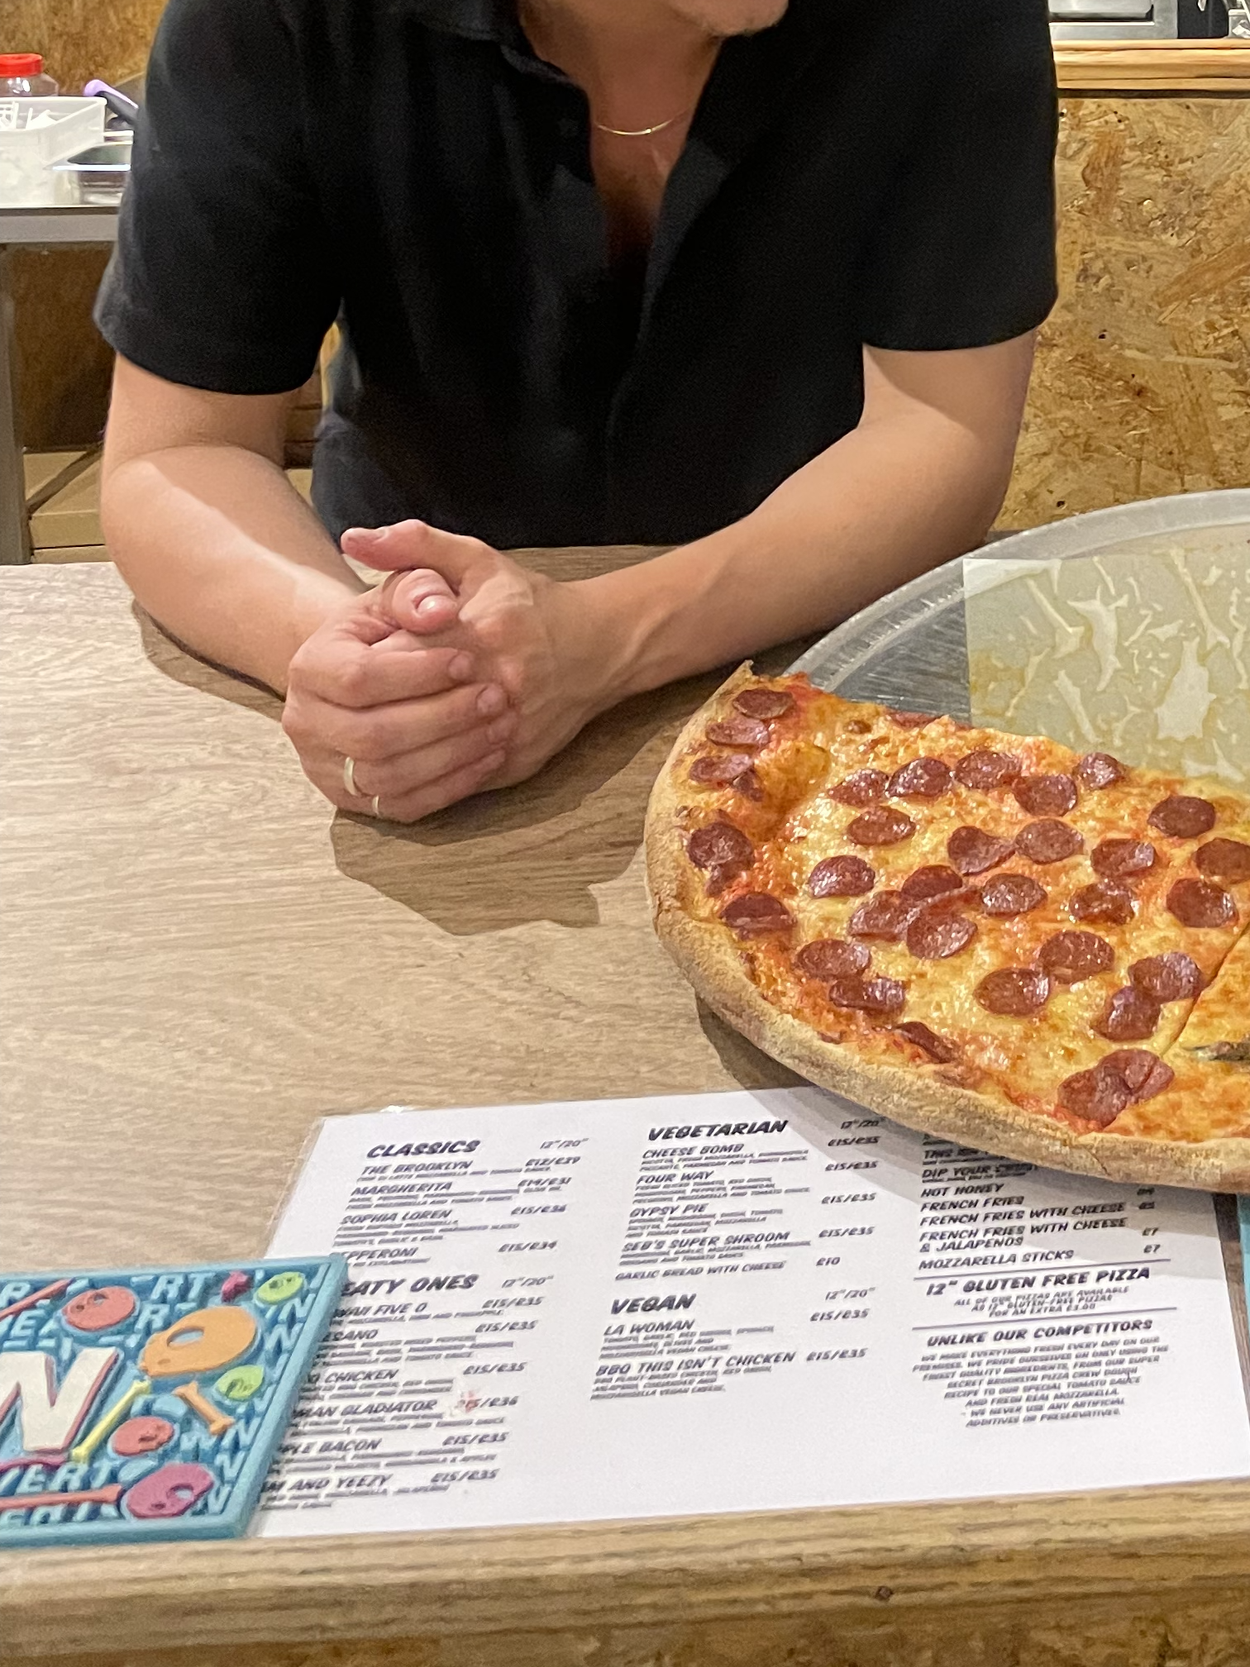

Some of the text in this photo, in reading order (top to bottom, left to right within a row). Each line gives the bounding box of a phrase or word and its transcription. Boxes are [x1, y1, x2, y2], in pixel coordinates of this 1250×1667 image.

[648, 1120, 789, 1142] VEGETARIAN
[366, 1140, 482, 1159] CLASSICS
[642, 1146, 697, 1159] CHEESE
[700, 1143, 745, 1156] BOMB
[361, 1164, 392, 1177] THE
[393, 1160, 474, 1174] BROOKLYN
[637, 1172, 679, 1185] FOUR
[680, 1170, 715, 1182] WAY
[922, 1167, 949, 1179] DIP
[350, 1181, 453, 1197] MARGHERITA
[921, 1183, 1005, 1199] HOT HONEY
[629, 1205, 680, 1219] GYPSY
[683, 1202, 710, 1215] PIE
[920, 1200, 980, 1213] FRENCH
[982, 1195, 1025, 1209] FRIES
[340, 1212, 399, 1226] SOPHIA
[401, 1209, 453, 1223] LOREN
[920, 1213, 980, 1227] FRENCH
[983, 1209, 1026, 1223] FRIES
[1029, 1206, 1070, 1220] WITH
[1071, 1202, 1128, 1215] CHEESE
[919, 1217, 1129, 1243] FRENCH FRIES WITH CHEESE
[668, 1235, 722, 1249] SUPER
[724, 1231, 791, 1246] SHROOM
[342, 1246, 419, 1261] PPERONI
[918, 1253, 1018, 1271] MOZZARELLA
[1022, 1249, 1075, 1264] STICKS
[615, 1268, 661, 1282] GARLIC
[662, 1266, 704, 1279] BREAD
[706, 1264, 740, 1277] WITH
[926, 1266, 1151, 1296] 12" GLUTEN FREE PIZZA
[341, 1278, 407, 1297] EATY
[410, 1274, 480, 1293] ONES
[373, 1302, 413, 1316] FIVE
[610, 1293, 698, 1315] VEGAN
[602, 1323, 627, 1337] LA
[630, 1319, 696, 1335] WOMAN
[926, 1318, 1154, 1348] UNLIKE OUR COMPETITORS
[637, 1359, 675, 1374] THIS
[677, 1355, 722, 1371] ISN'T
[726, 1351, 798, 1367] CHICKEN
[325, 1368, 400, 1384] CHICKEN
[340, 1399, 439, 1417] GLADIATOR
[319, 1437, 384, 1453] BACON
[289, 1476, 331, 1491] AND
